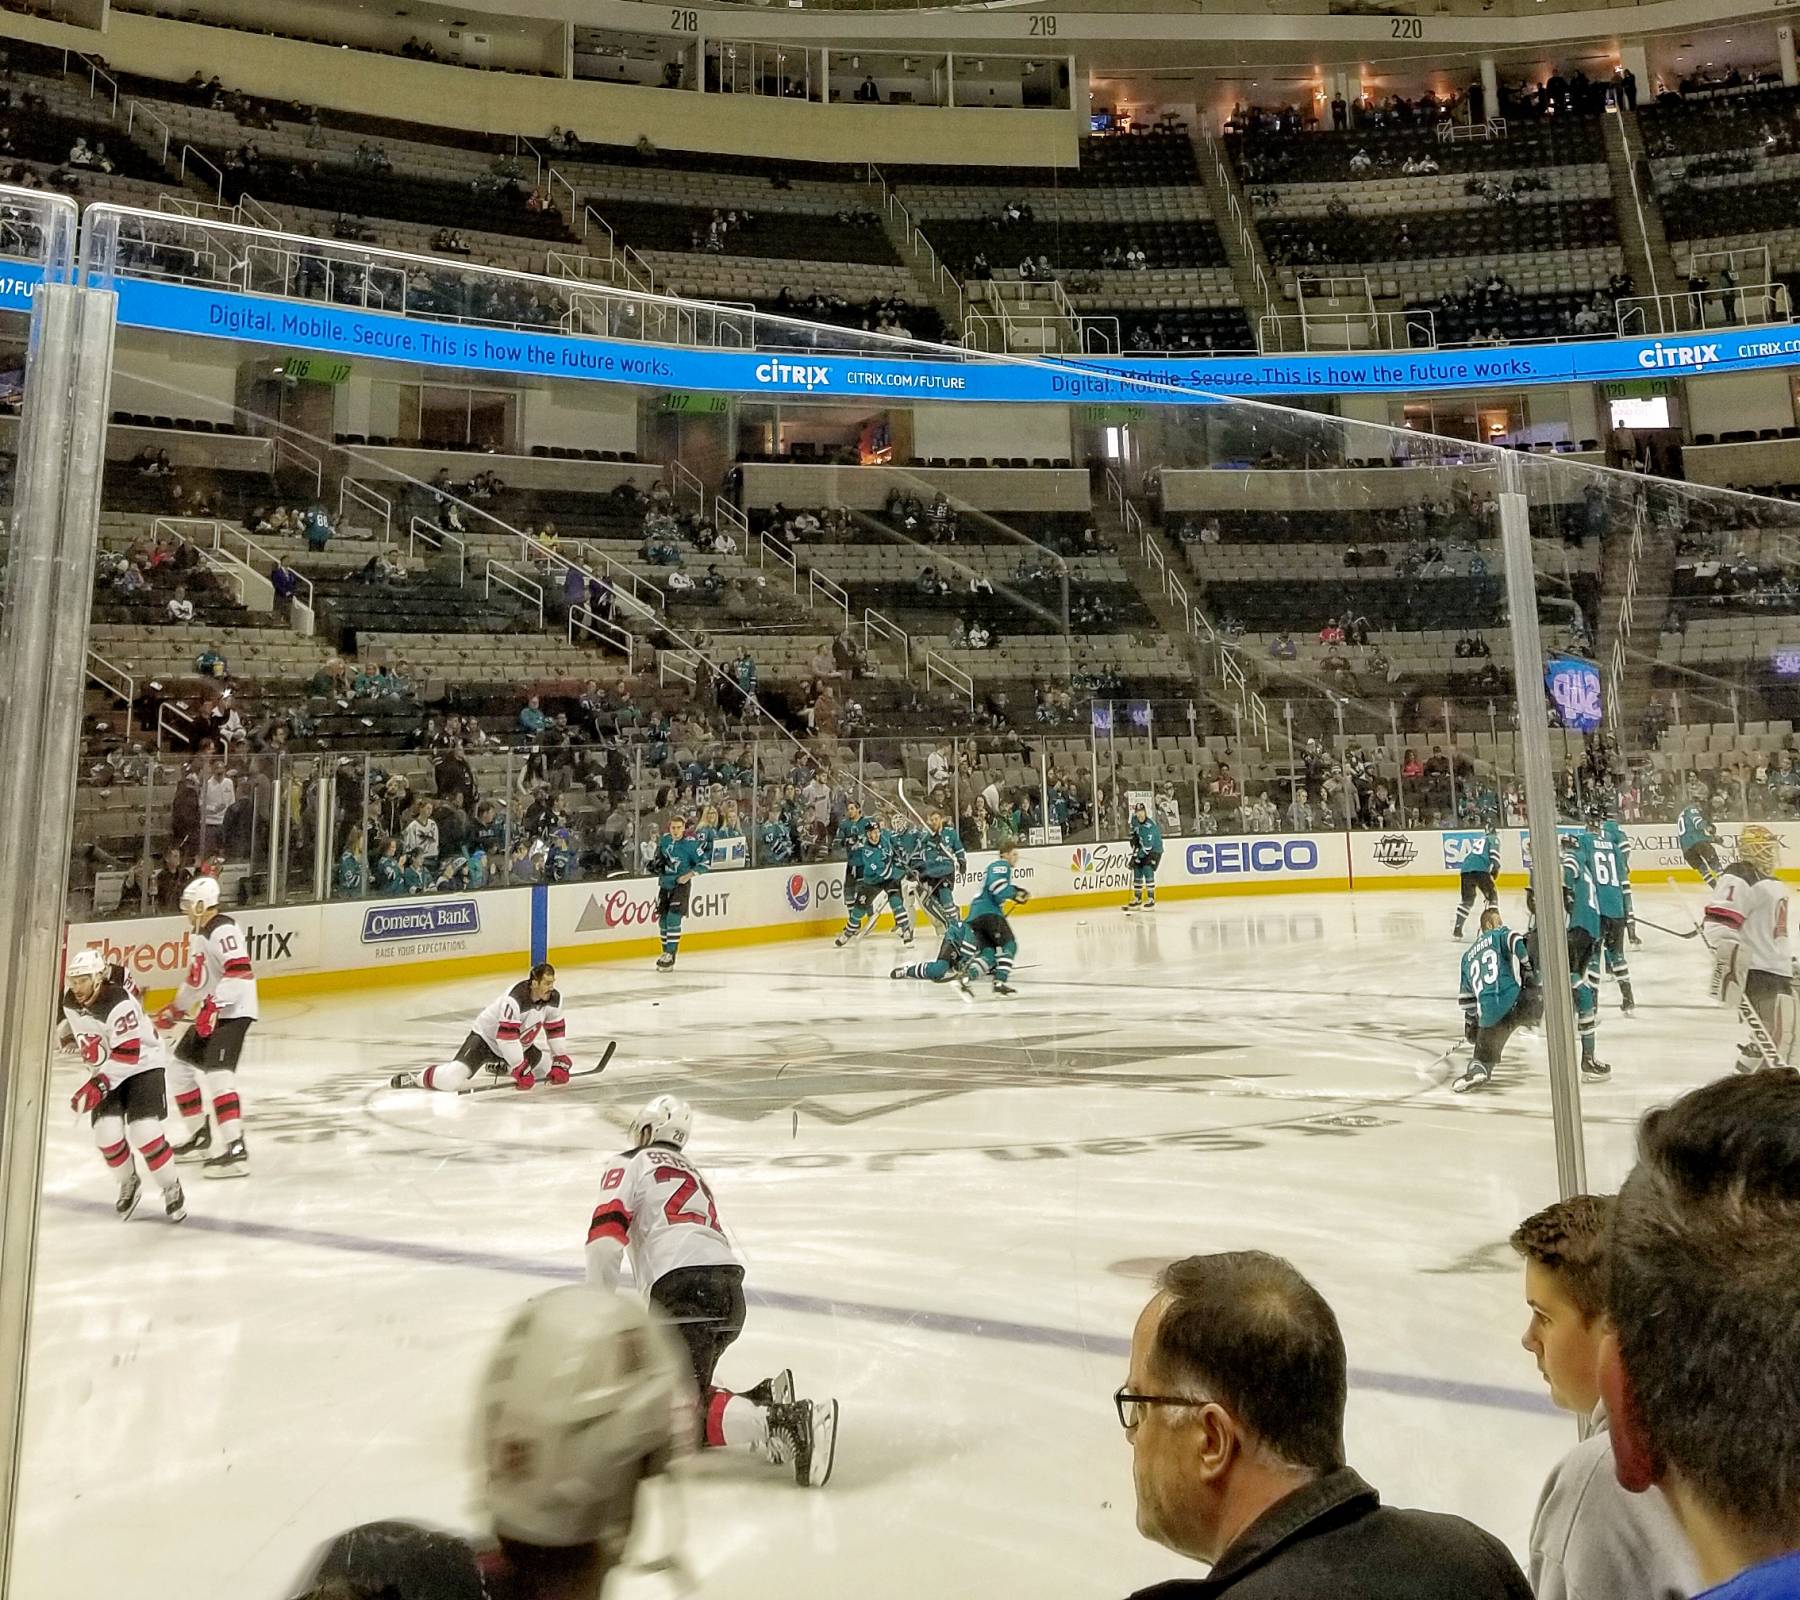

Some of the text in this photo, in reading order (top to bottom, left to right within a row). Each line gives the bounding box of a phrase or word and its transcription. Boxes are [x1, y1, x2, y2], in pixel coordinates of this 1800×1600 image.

[670, 10, 699, 33] 218
[1029, 14, 1057, 37] 219
[1390, 17, 1424, 40] 220
[209, 303, 675, 378] Digital. Mobile. Secure. This is how the future works.
[847, 370, 966, 390] CITRIX.COM/FUTURE
[1051, 373, 1117, 396] Digital.
[1263, 366, 1300, 386] This
[1306, 365, 1322, 384] is
[1328, 361, 1366, 385] how
[1373, 358, 1404, 383] the
[1409, 358, 1467, 382] future
[1474, 357, 1538, 378] works.
[1092, 844, 1134, 874] Sport
[1186, 839, 1318, 875] GEICO
[1374, 841, 1419, 858] NHL
[1444, 837, 1472, 863] SA
[1593, 851, 1620, 887] 61
[437, 907, 471, 926] Bank
[218, 934, 239, 954] 10
[1469, 948, 1499, 1002] 23
[113, 1009, 139, 1037] 39
